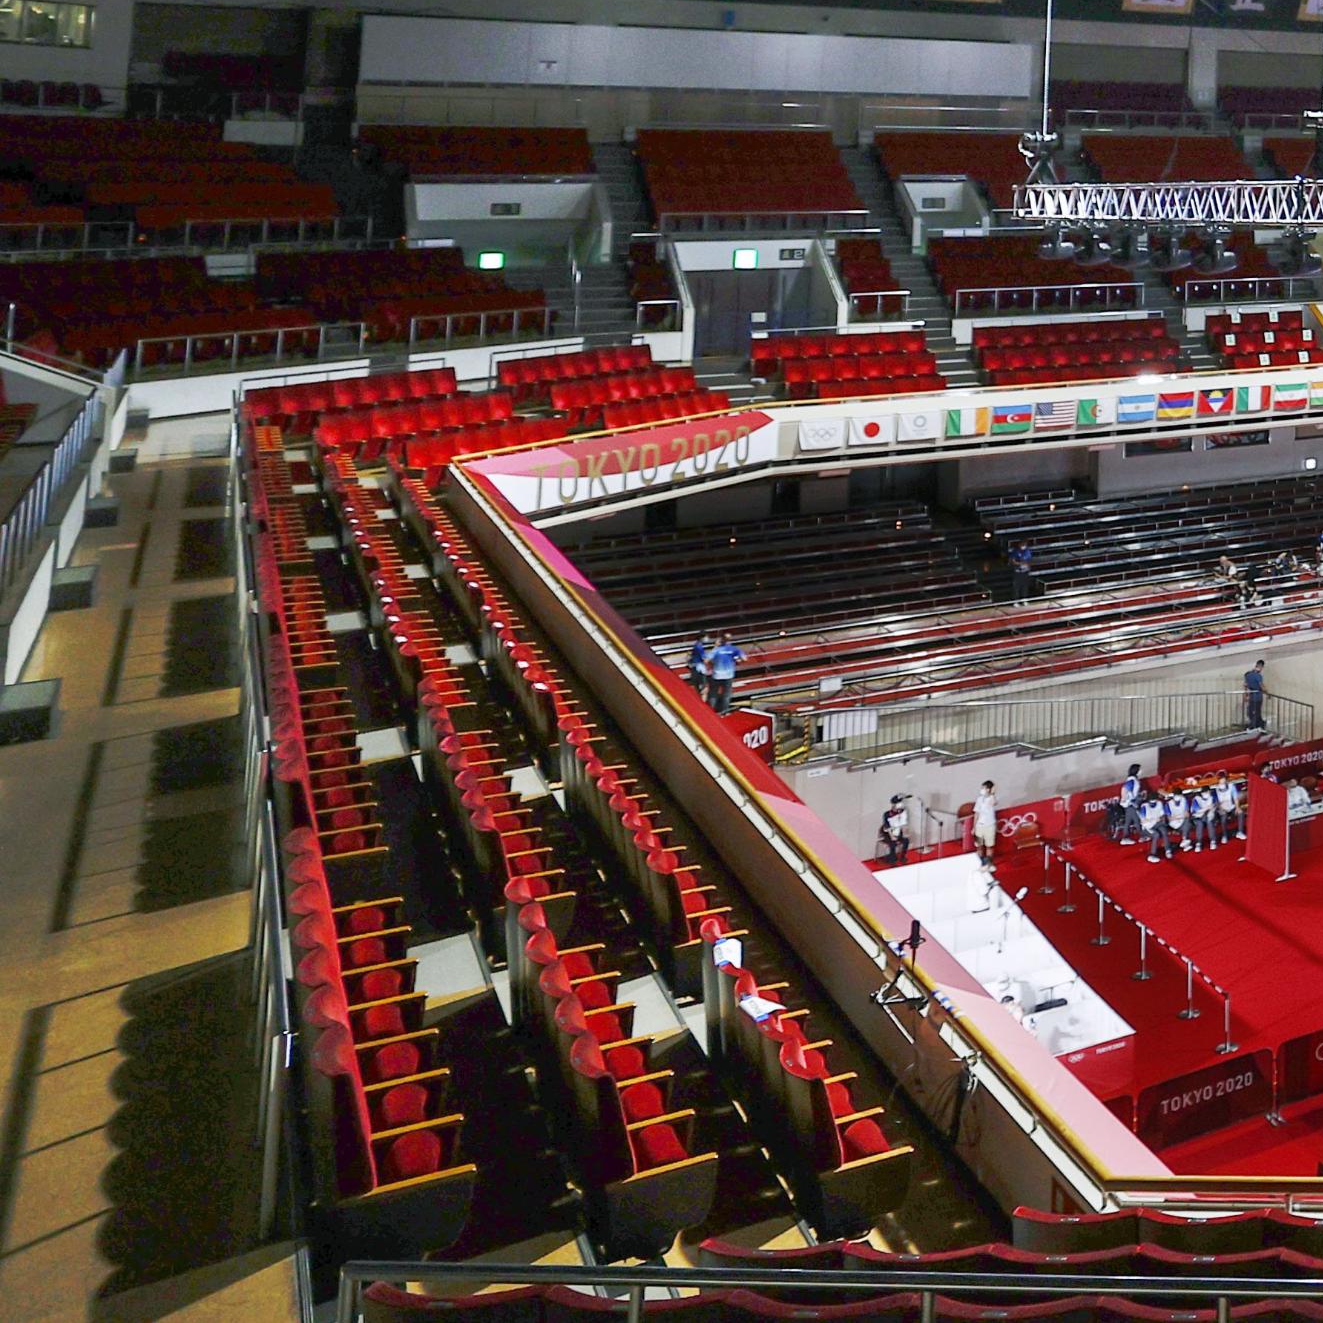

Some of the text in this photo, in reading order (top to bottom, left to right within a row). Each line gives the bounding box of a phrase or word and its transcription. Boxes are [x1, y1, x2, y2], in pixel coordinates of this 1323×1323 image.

[528, 425, 751, 510] TOKYO 2020
[1160, 1071, 1253, 1115] TOKYO 2020
